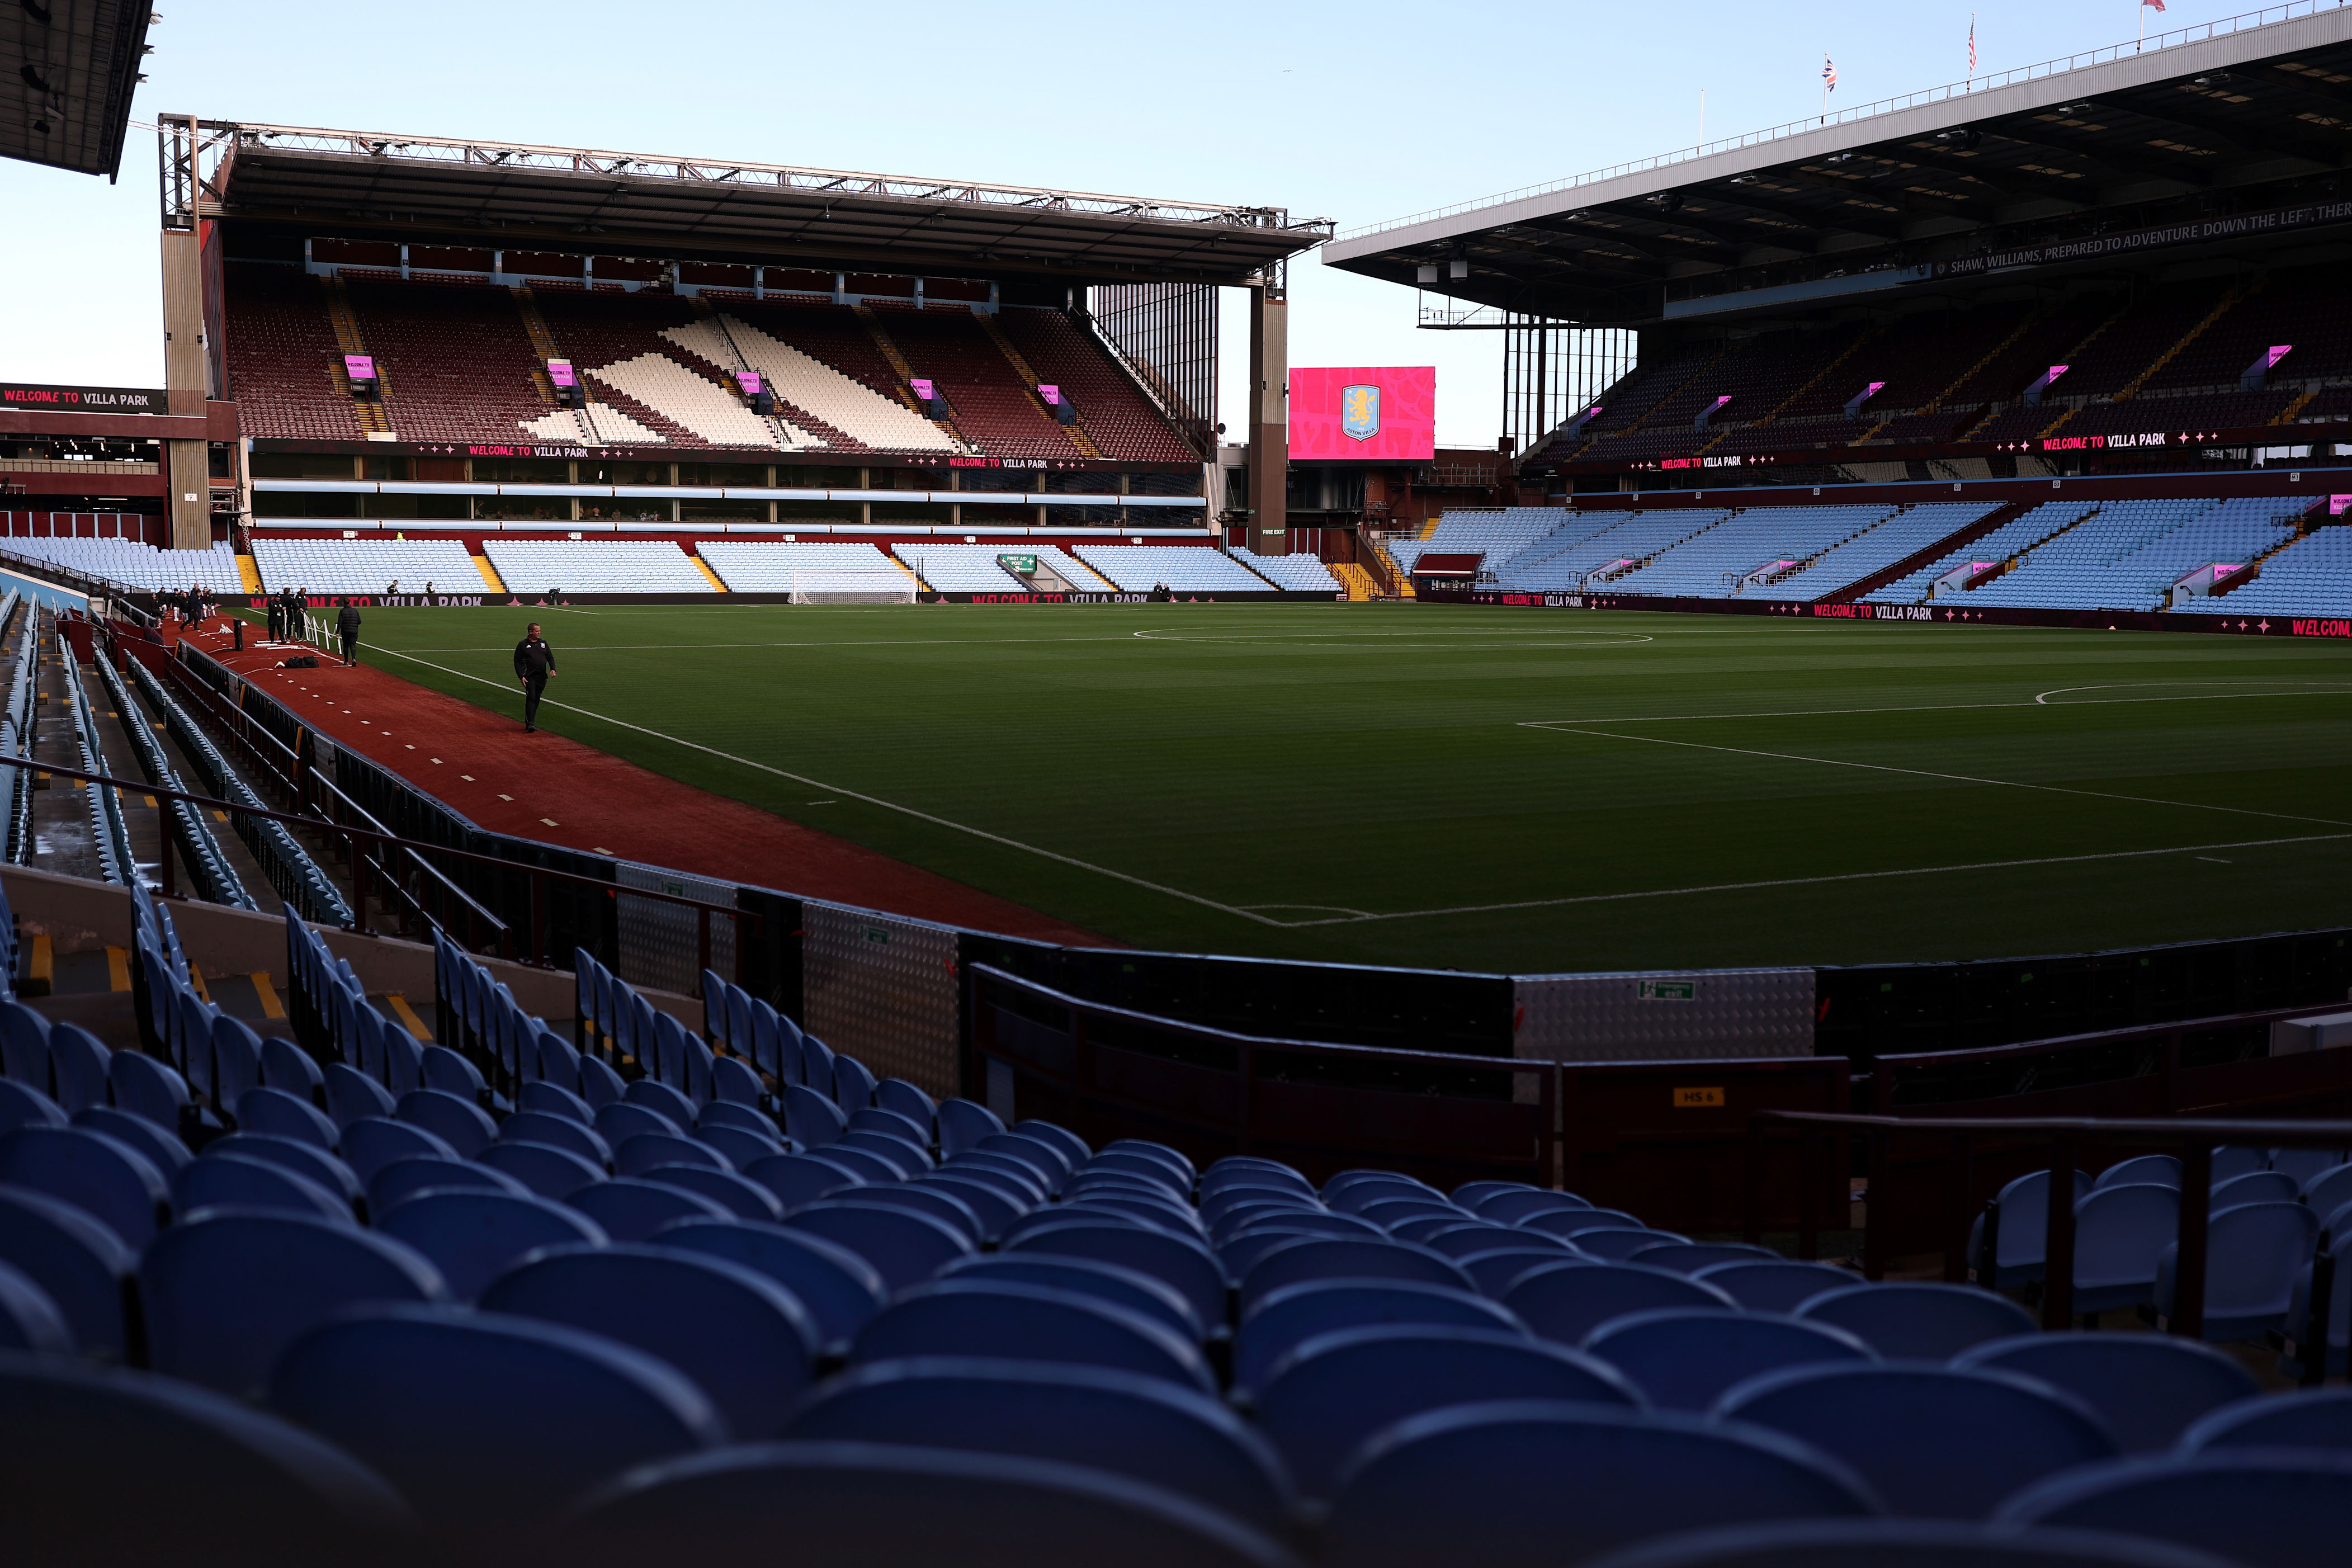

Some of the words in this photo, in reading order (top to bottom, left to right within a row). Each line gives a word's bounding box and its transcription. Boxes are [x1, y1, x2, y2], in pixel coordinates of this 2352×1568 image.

[1951, 258, 1985, 273] SHAW,
[1986, 249, 2042, 268] WILLIAMS,
[2044, 240, 2103, 259] PREPARED
[2105, 237, 2121, 251] TO
[2123, 225, 2198, 248] ADVENTURE
[2203, 218, 2247, 237] DOWN
[2250, 212, 2277, 229] THE
[4, 390, 60, 403] WELCOME
[62, 392, 79, 403] TO
[83, 393, 117, 405] VILLA
[120, 394, 149, 406] PARK
[1346, 427, 1362, 436] ASTON
[2043, 436, 2088, 451] WELCOME
[2090, 435, 2104, 448] TO
[2107, 434, 2136, 448] VILLA
[2139, 432, 2166, 446] PARK
[469, 445, 514, 456] WELCOME
[516, 446, 531, 456] TO
[534, 447, 561, 457] VILLA
[564, 447, 589, 457] PARK
[949, 457, 986, 467] WELCOME
[988, 459, 1000, 467] TO
[1003, 459, 1026, 469] VILLA
[1027, 460, 1047, 469] PARK
[1661, 458, 1691, 470] WELCOME
[1692, 457, 1702, 468] TO
[1703, 456, 1722, 467] VILLA
[1723, 456, 1741, 466] PARK
[348, 597, 371, 607] TO
[379, 597, 428, 607] VILLA
[438, 597, 483, 606] PARK
[972, 594, 1038, 603] WELCOME
[1043, 594, 1063, 603] TO
[1069, 594, 1108, 603] VILLA
[1114, 594, 1148, 603] PARK
[1503, 594, 1531, 605] WELCOME
[1533, 595, 1543, 606] TO
[1545, 596, 1564, 607] VILLA
[1565, 596, 1583, 607] PARK
[1814, 604, 1857, 618] WELCOME
[1859, 605, 1872, 618] TO
[1876, 606, 1904, 620] VILLA
[1907, 607, 1932, 620] PARK
[2292, 620, 2352, 637] WELCOM
[1665, 989, 1683, 998] exit
[1684, 1092, 1703, 1102] HS
[1706, 1092, 1714, 1102] 6
